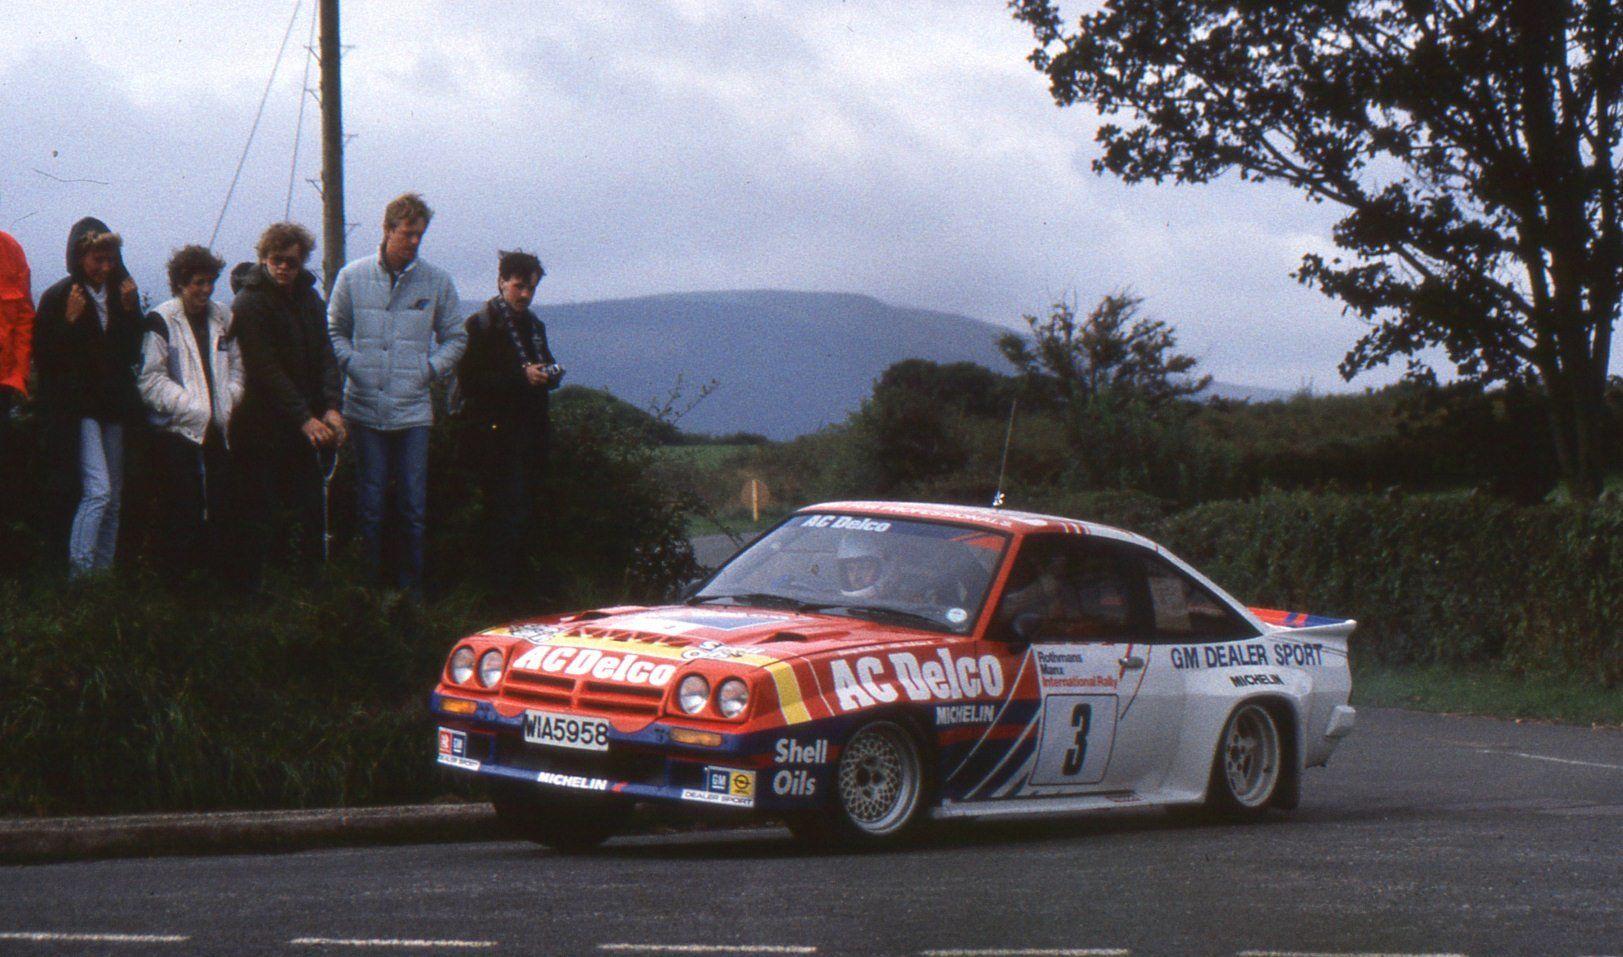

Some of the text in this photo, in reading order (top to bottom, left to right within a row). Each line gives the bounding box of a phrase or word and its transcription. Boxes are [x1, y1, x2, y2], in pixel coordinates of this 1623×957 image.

[801, 515, 891, 532] AC Delco
[512, 646, 568, 671] AC
[563, 648, 677, 687] Delco
[1038, 651, 1083, 663] Rothmans
[1171, 643, 1323, 669] GM DEALER SPORT
[830, 648, 1004, 711] AC Delco
[1042, 675, 1118, 691] International Rally
[1230, 674, 1285, 687] MICHELIN
[935, 704, 995, 725] MICHELIN
[523, 714, 608, 746] WIA5958
[1062, 702, 1093, 776] 3
[774, 738, 828, 764] Shell
[537, 772, 608, 790] MICHELIN
[772, 769, 817, 796] Oils
[684, 791, 752, 806] DEALER SPORT
